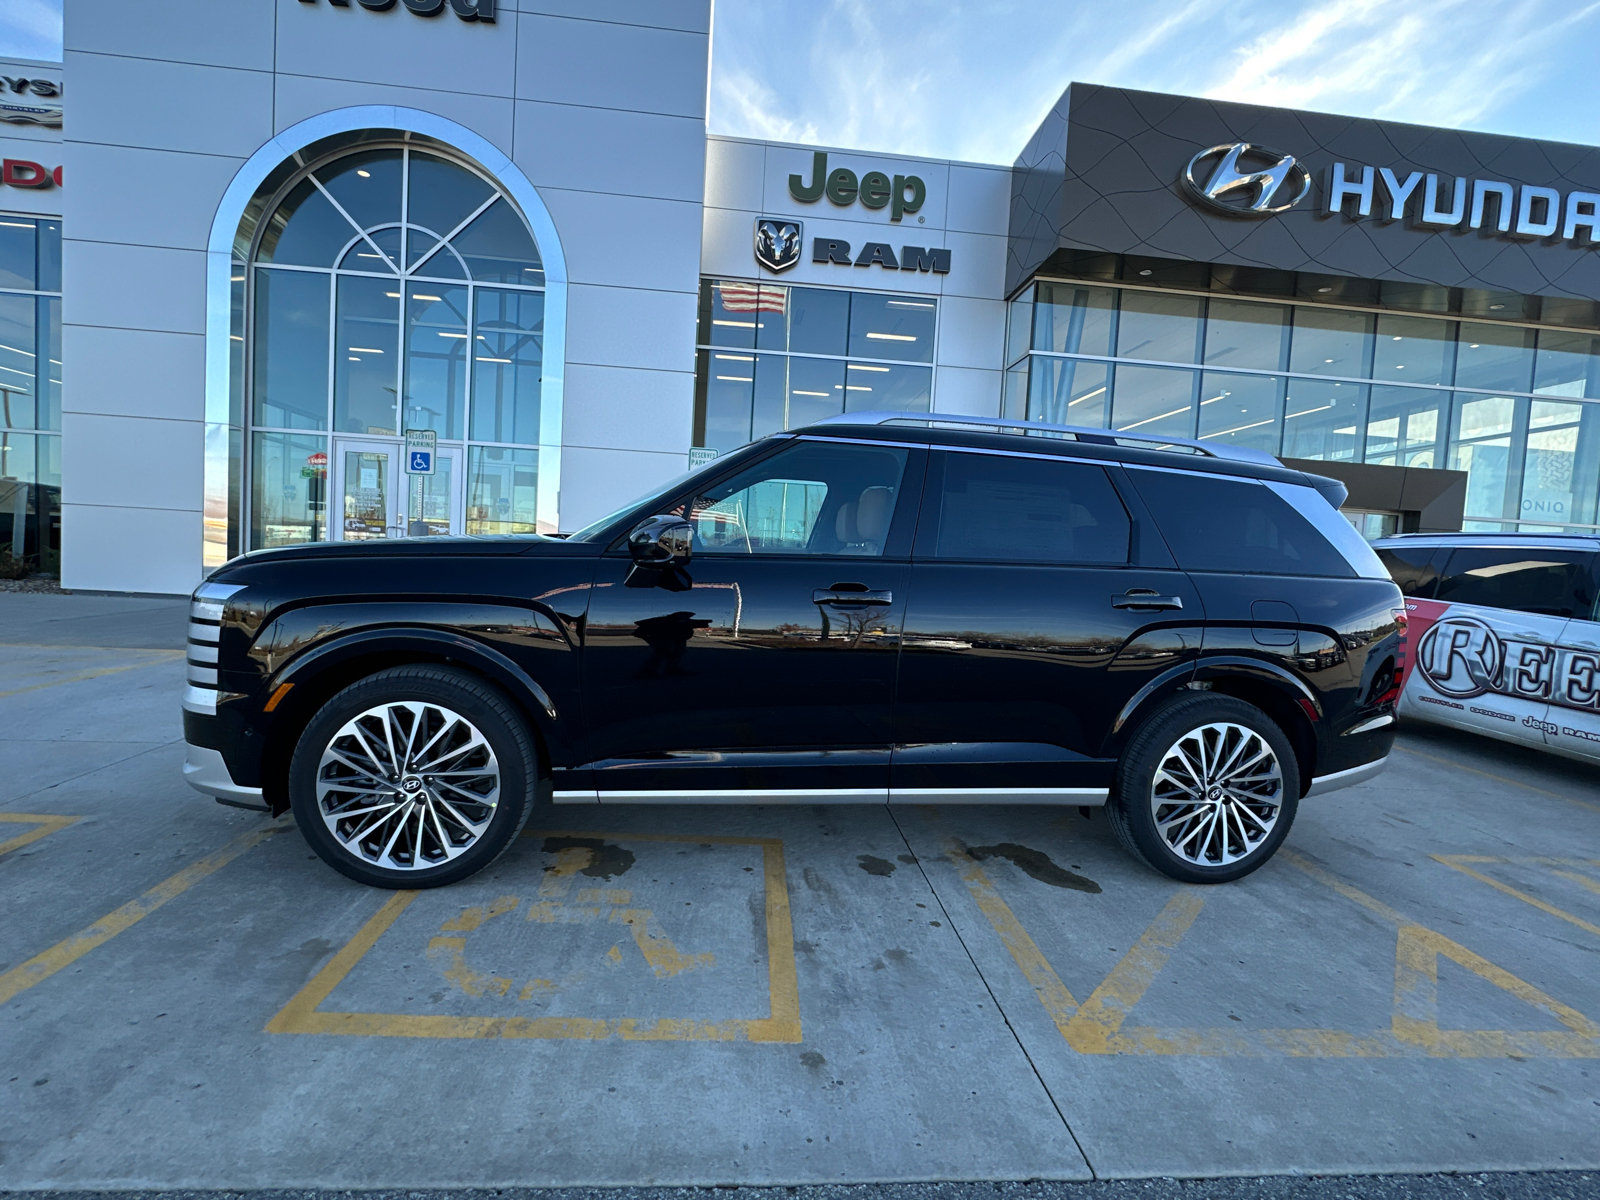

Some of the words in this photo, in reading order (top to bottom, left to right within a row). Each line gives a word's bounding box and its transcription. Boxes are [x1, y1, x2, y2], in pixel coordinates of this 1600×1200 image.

[0, 75, 63, 96] YS
[788, 151, 926, 222] Jeep
[812, 237, 952, 274] RAM
[408, 432, 434, 440] RESERVED
[692, 451, 716, 459] RESERVED
[1470, 706, 1515, 722] DODGE
[1522, 715, 1558, 735] Jeep
[1563, 727, 1600, 743] RAM
